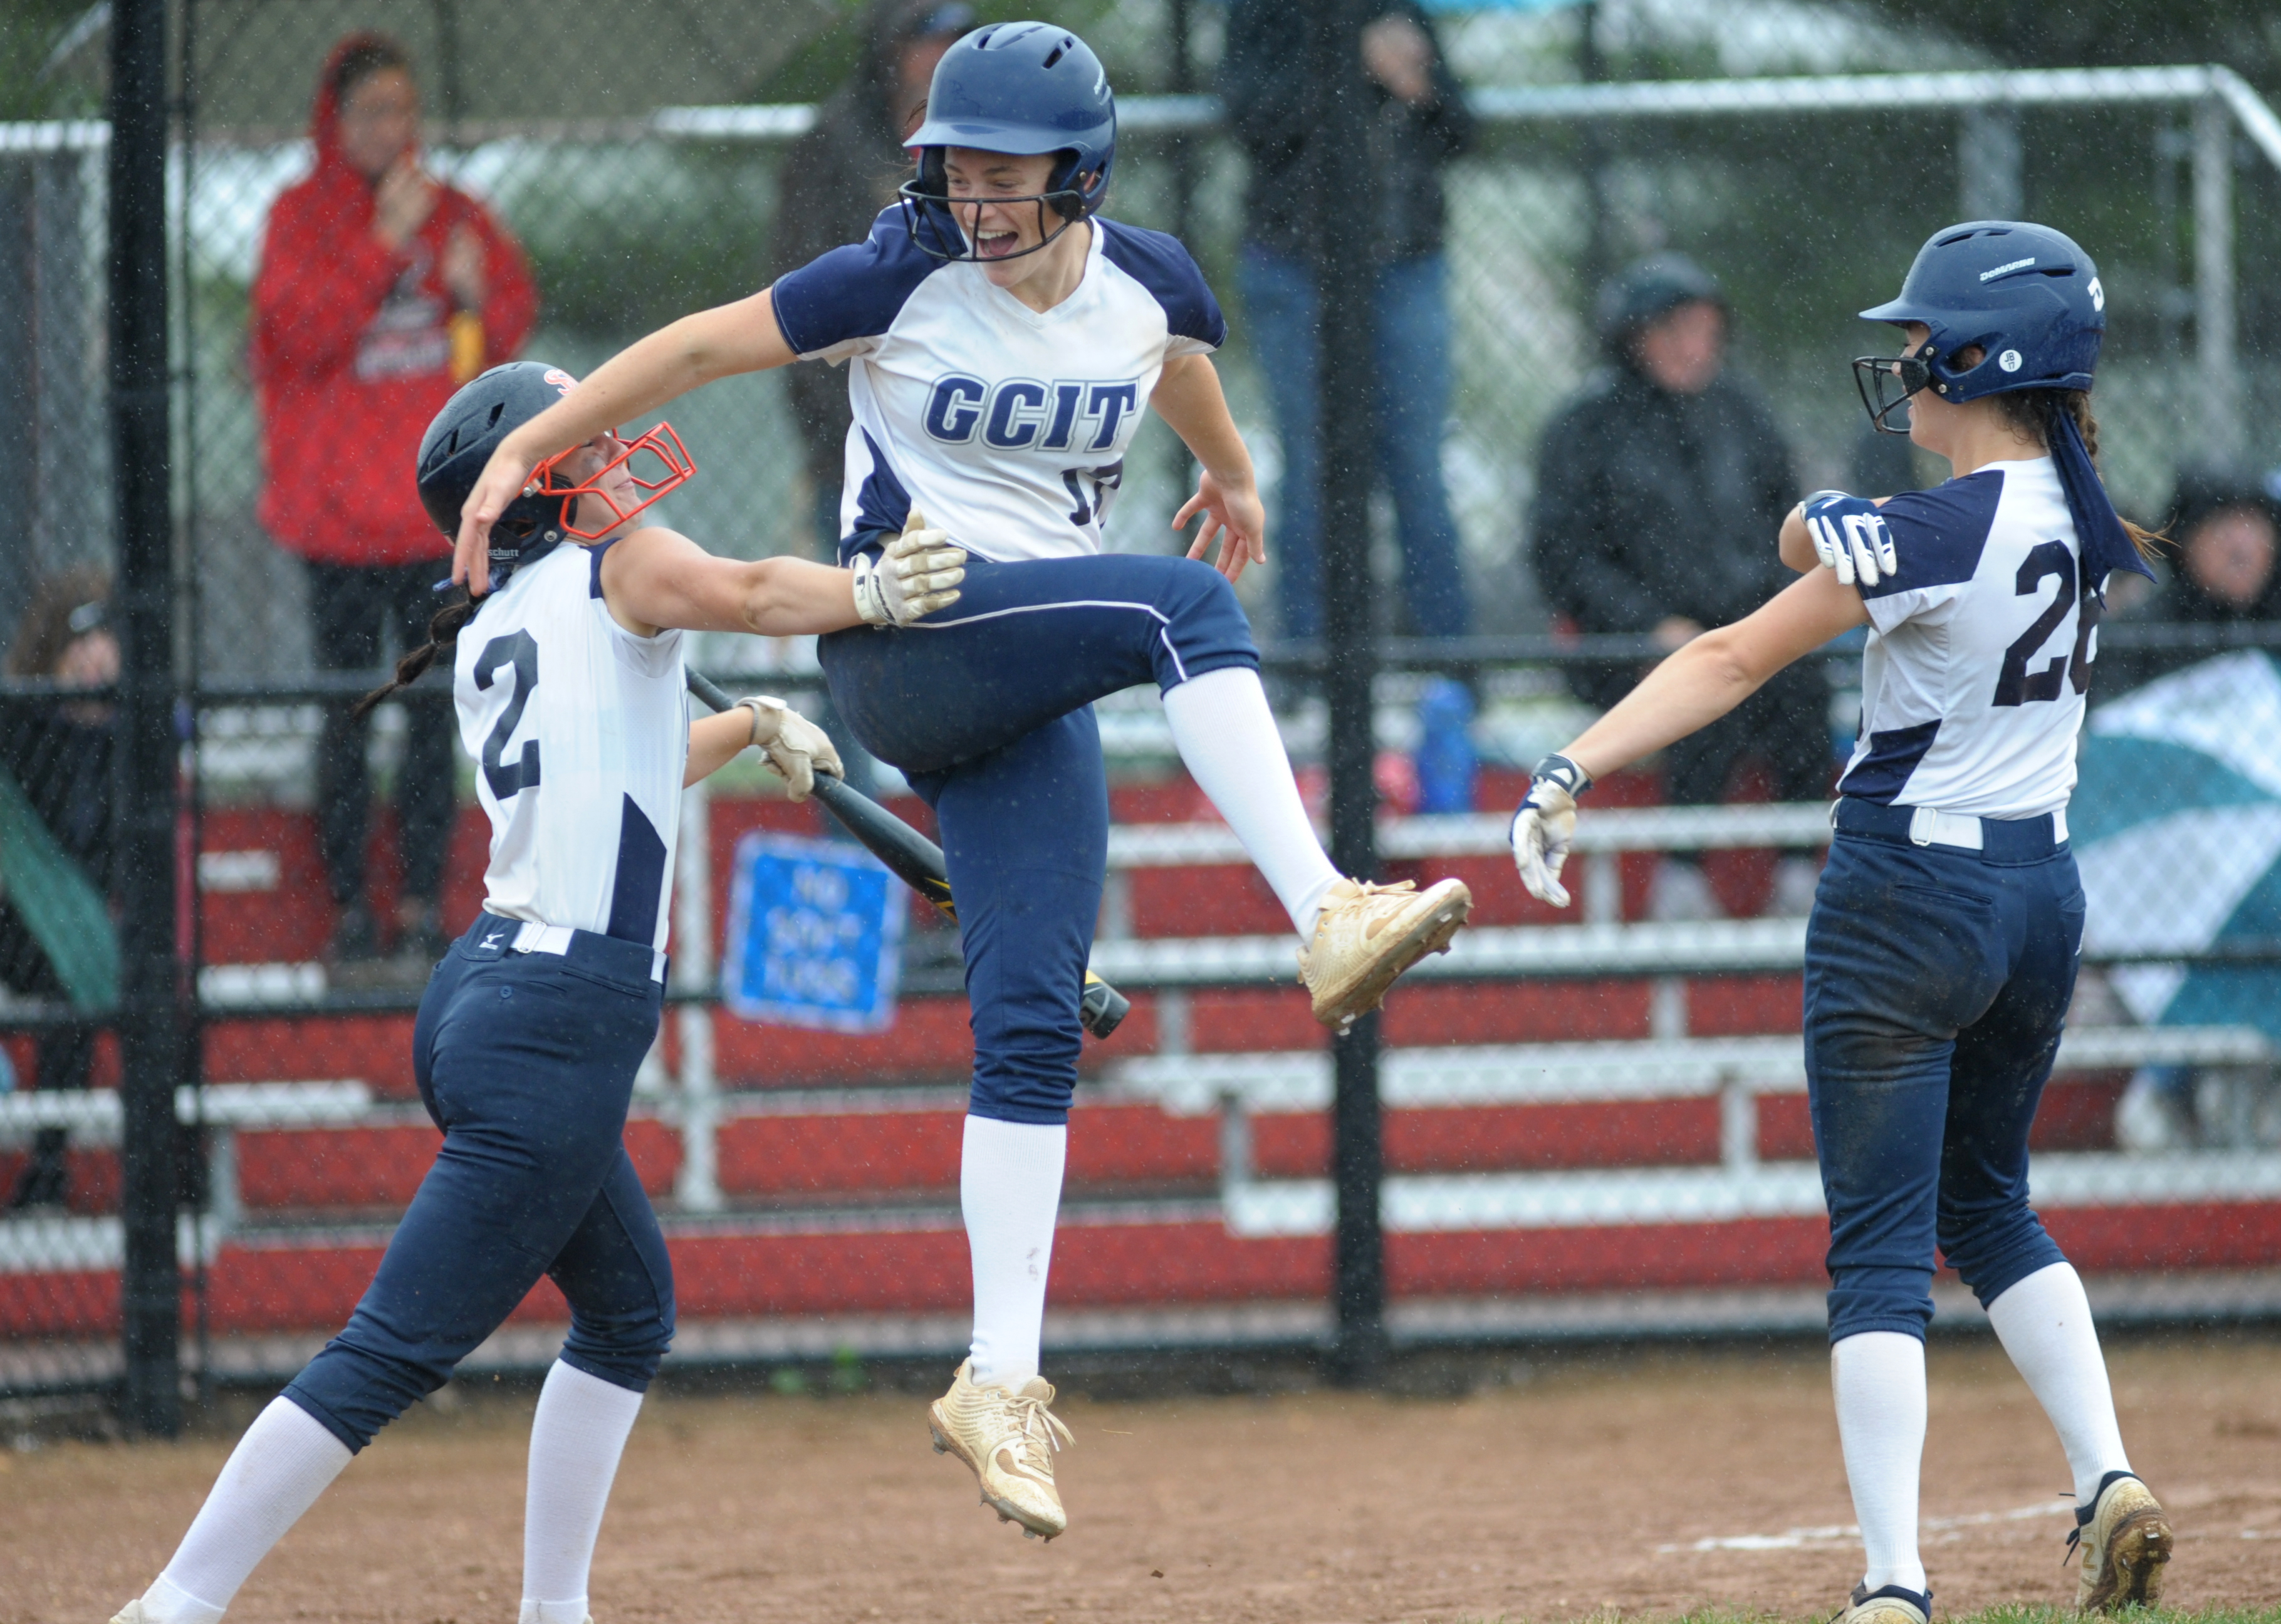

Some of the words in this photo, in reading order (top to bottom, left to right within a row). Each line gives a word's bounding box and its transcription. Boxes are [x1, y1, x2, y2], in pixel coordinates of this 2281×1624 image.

[2004, 351, 2015, 362] JB
[922, 372, 1139, 452] GCIT
[487, 547, 519, 557] schutt
[473, 627, 541, 801] 2
